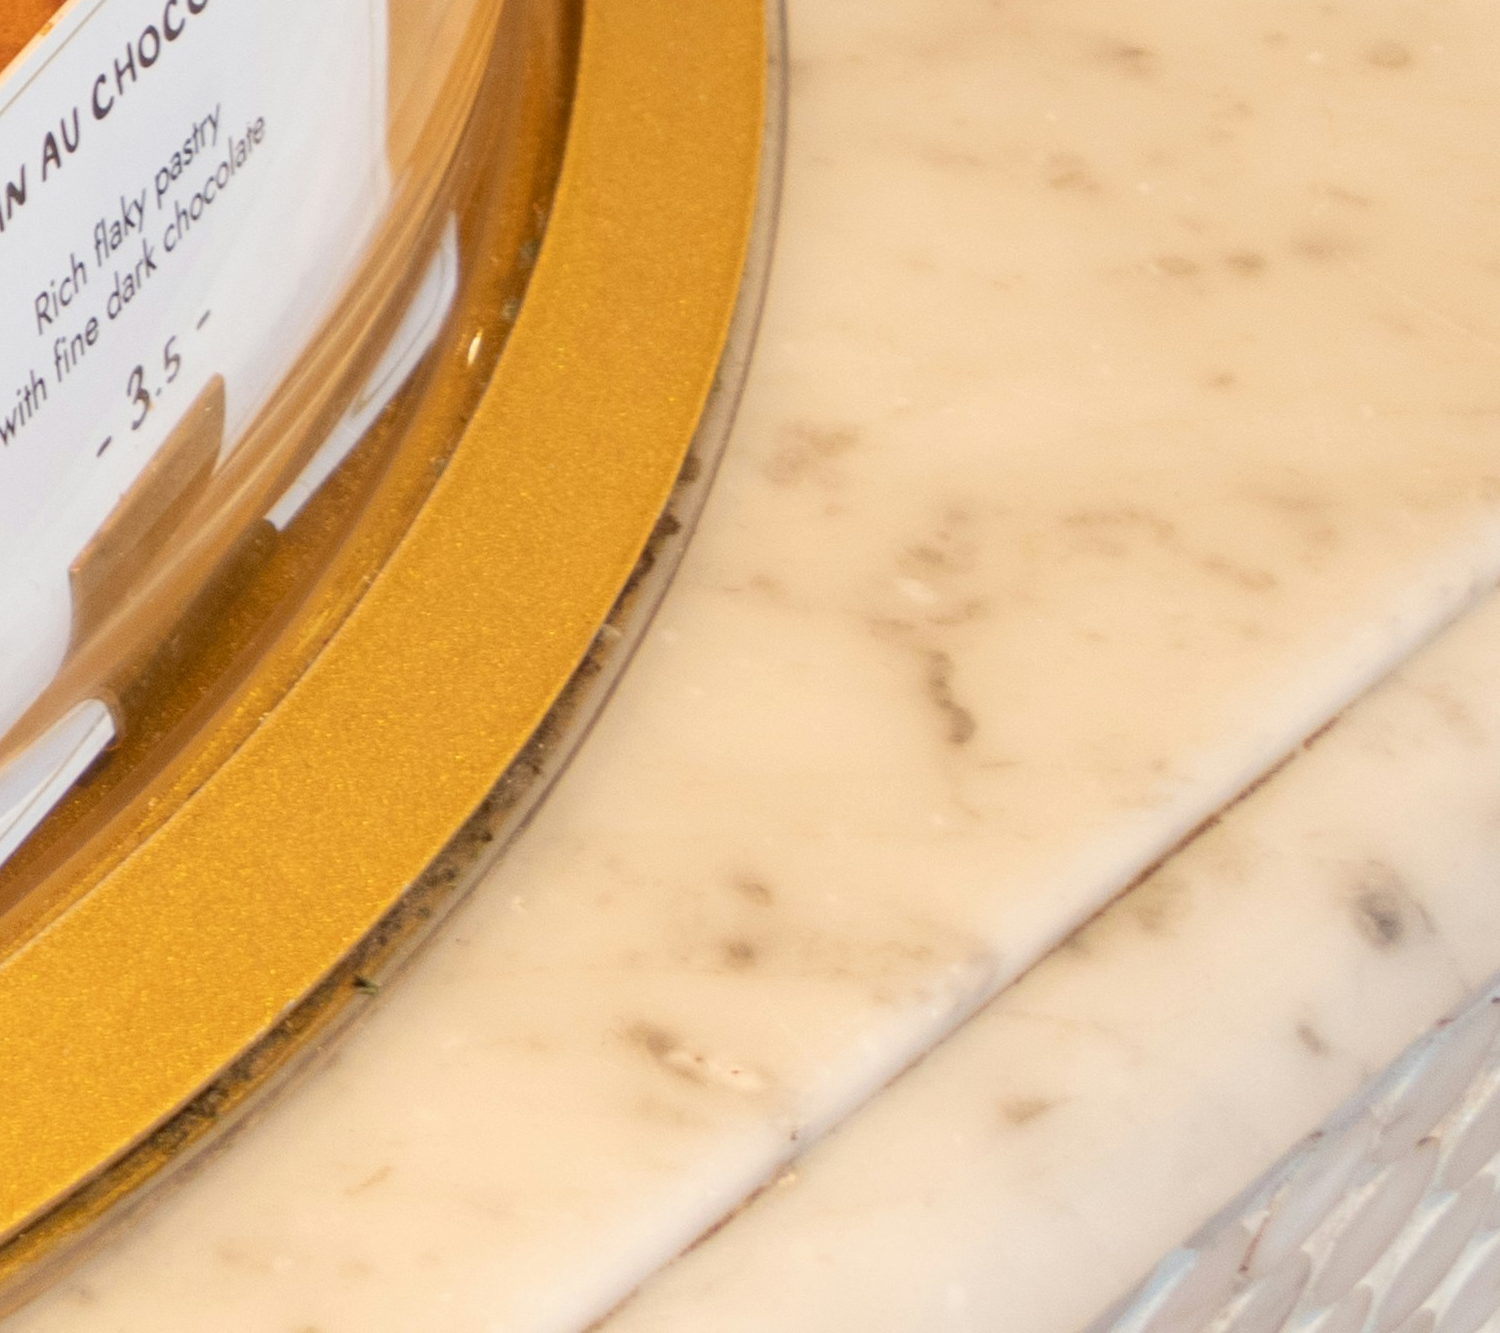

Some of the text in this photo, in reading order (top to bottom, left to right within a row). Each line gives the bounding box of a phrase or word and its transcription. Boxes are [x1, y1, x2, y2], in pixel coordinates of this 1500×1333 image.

[34, 102, 221, 335] Rich flaky pastry
[41, 106, 80, 183] AU
[53, 317, 100, 383] fine
[106, 238, 158, 321] dark
[163, 116, 265, 253] chocolate
[126, 334, 182, 431] 3.5
